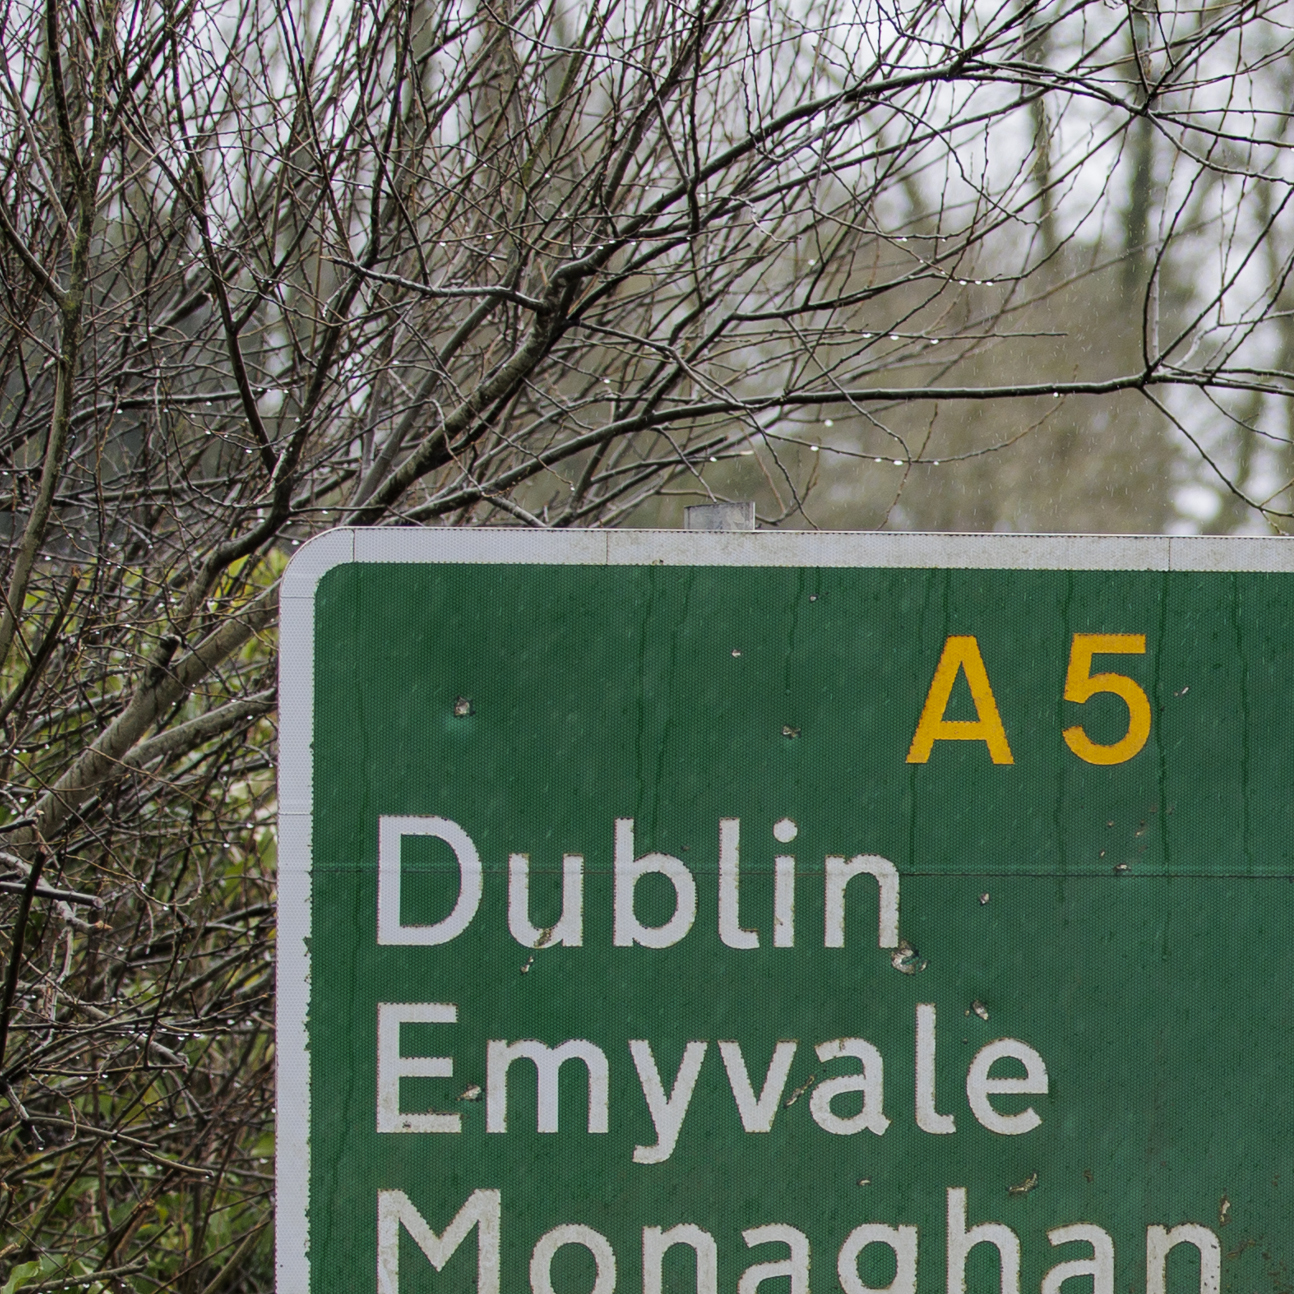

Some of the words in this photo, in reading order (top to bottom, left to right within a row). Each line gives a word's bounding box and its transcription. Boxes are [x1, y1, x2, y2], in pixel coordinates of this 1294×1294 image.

[905, 635, 1015, 766] A
[1062, 633, 1153, 766] 5
[376, 815, 901, 950] Dublin
[375, 1002, 1050, 1165] Emyvale
